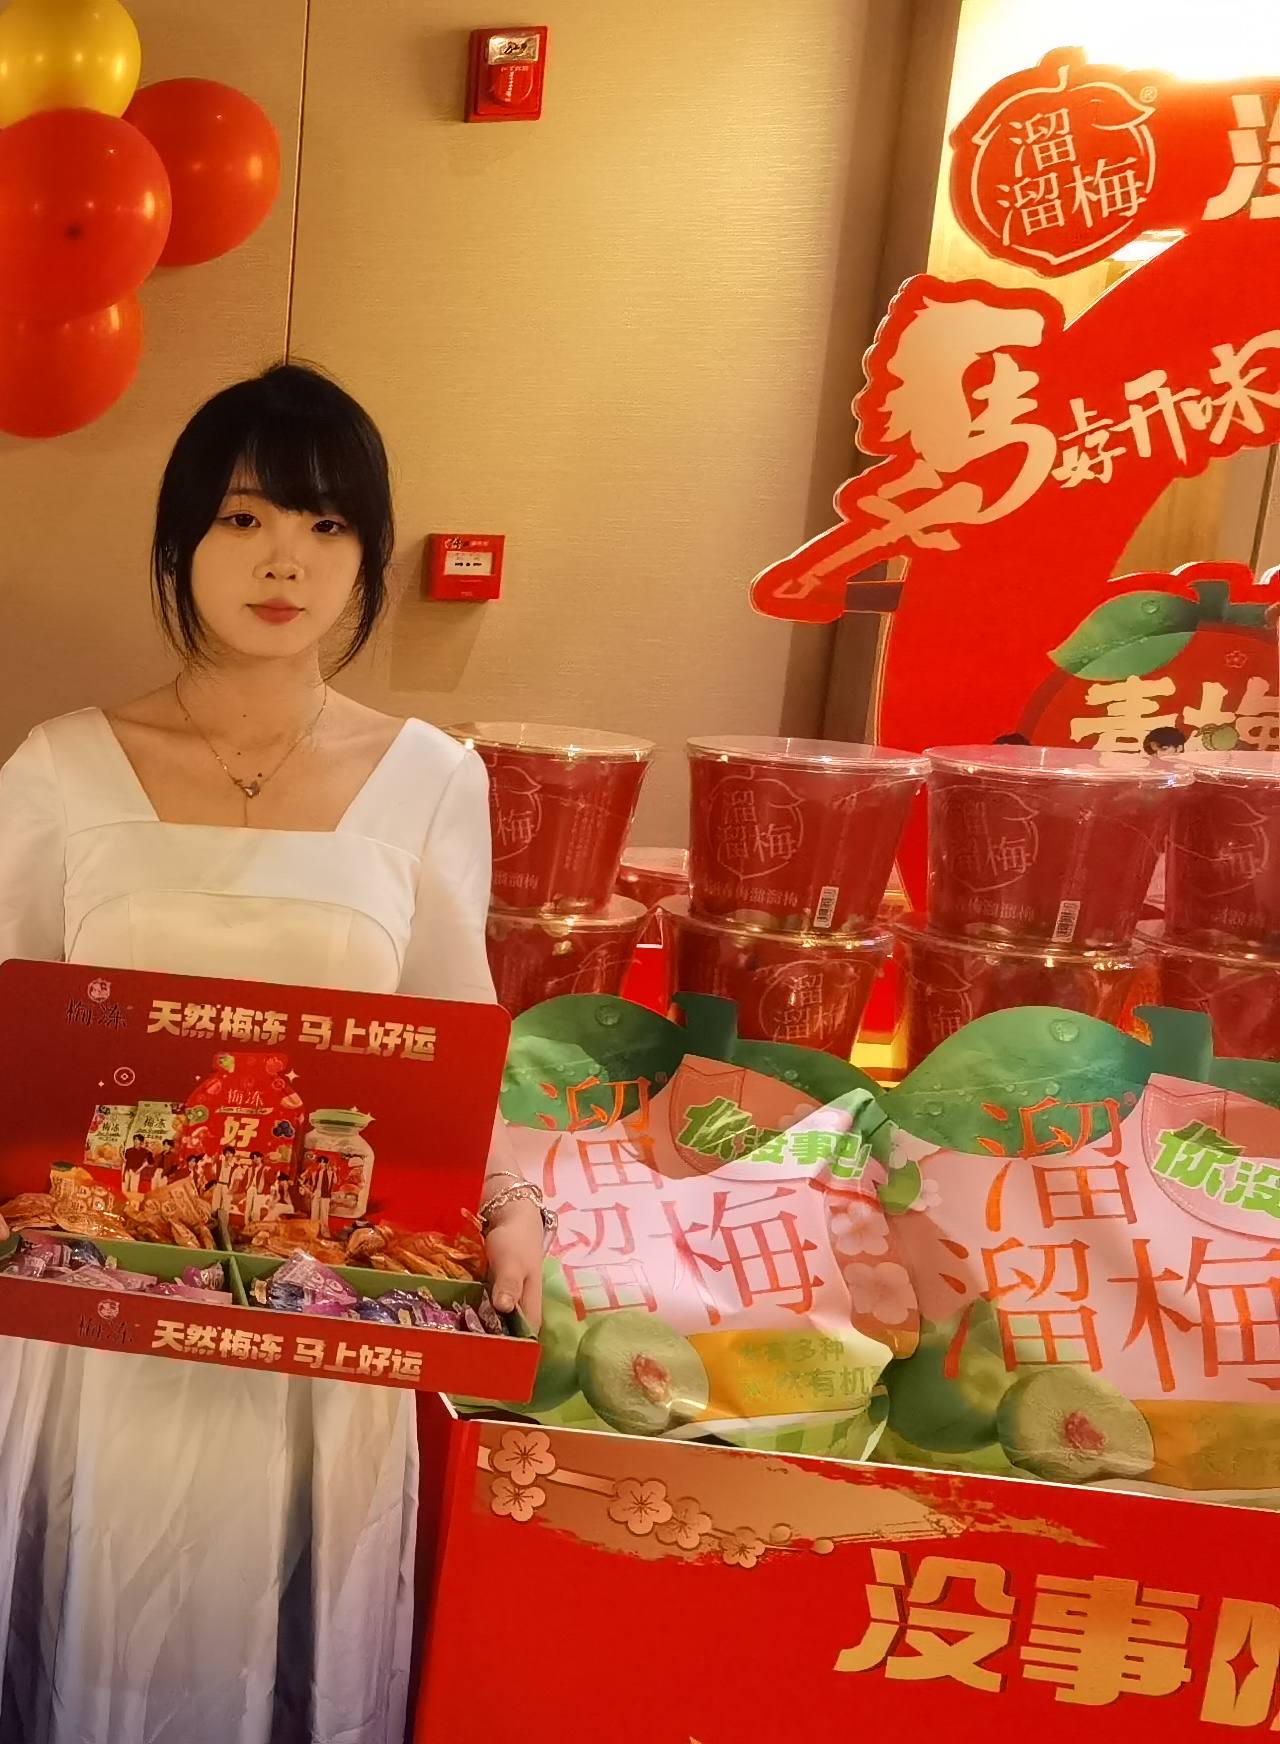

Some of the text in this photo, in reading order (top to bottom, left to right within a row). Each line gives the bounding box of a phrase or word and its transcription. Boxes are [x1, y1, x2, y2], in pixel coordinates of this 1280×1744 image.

[146, 998, 438, 1063] 天然梅冻 马上好运
[538, 1075, 666, 1199] 溜
[977, 1095, 1140, 1232] 溜
[151, 1319, 424, 1383] 天然梅冻 马上好运
[938, 1235, 1280, 1393] 溜梅
